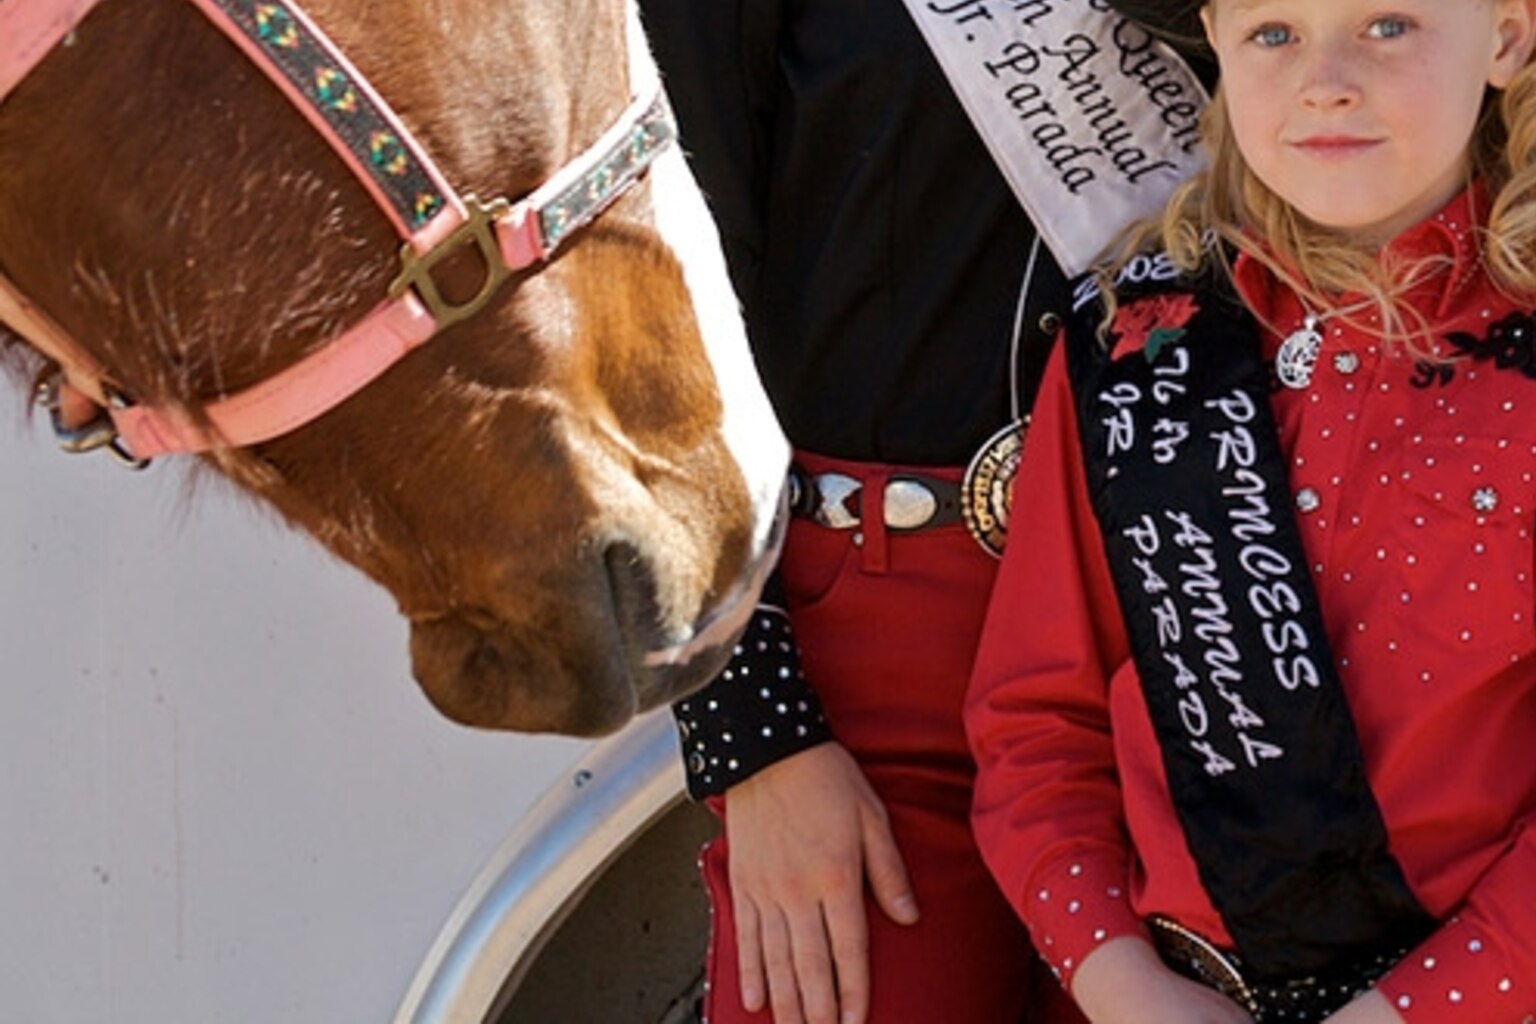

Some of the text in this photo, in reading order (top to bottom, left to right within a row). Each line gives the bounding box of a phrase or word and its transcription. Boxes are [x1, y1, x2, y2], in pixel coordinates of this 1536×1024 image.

[985, 41, 1097, 195] Parada
[1041, 34, 1177, 184] Annual
[1123, 515, 1236, 777] PARADA
[1166, 509, 1283, 768] ANNUAL
[1204, 389, 1319, 691] PRINCESS
